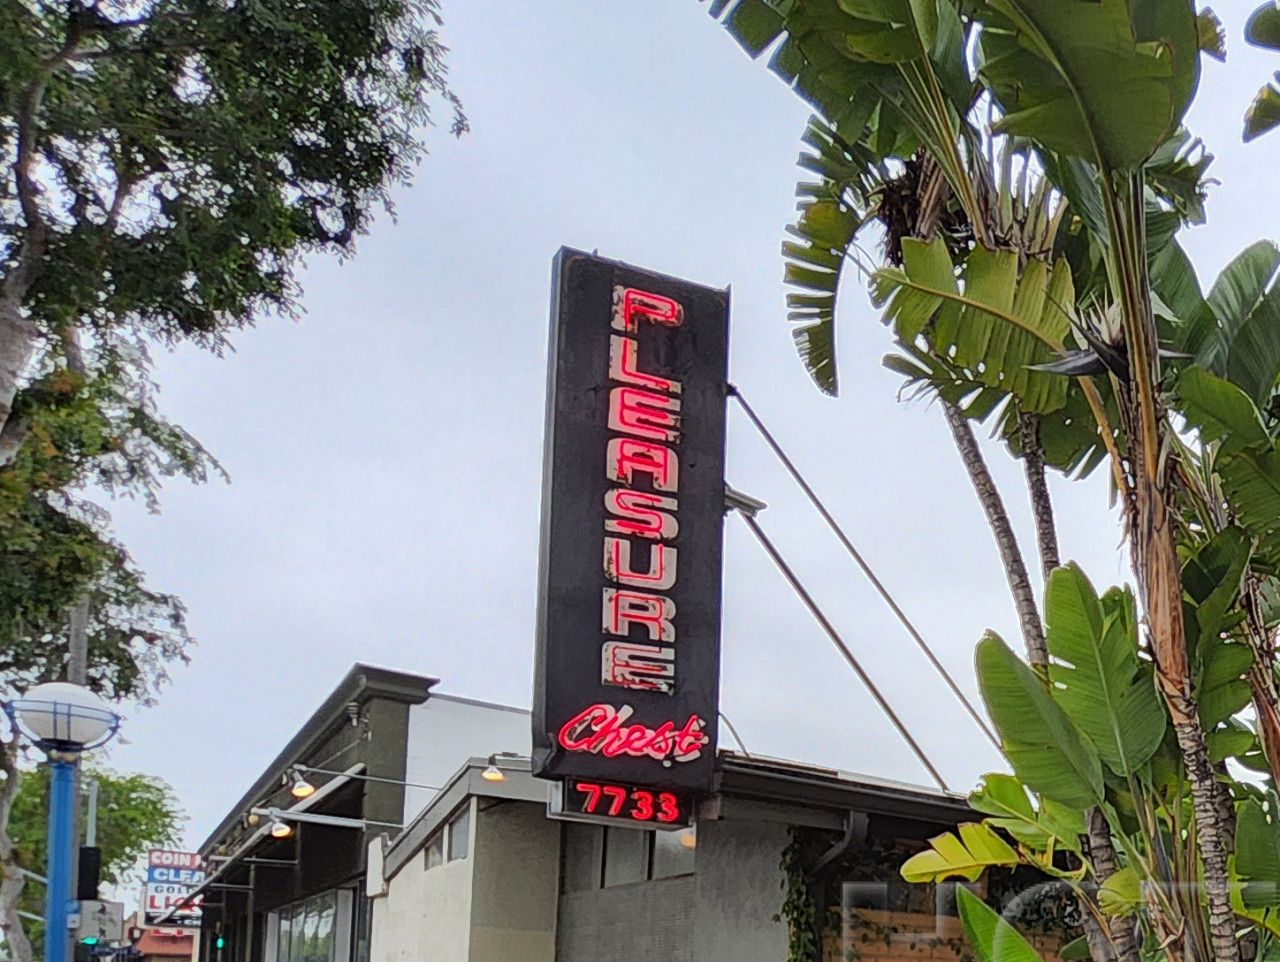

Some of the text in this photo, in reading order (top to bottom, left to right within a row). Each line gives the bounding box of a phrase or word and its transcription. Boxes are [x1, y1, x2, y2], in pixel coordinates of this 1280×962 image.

[601, 285, 684, 695] PLEASURE
[559, 704, 709, 763] Chest
[576, 783, 679, 822] 7733
[151, 851, 191, 867] COIN
